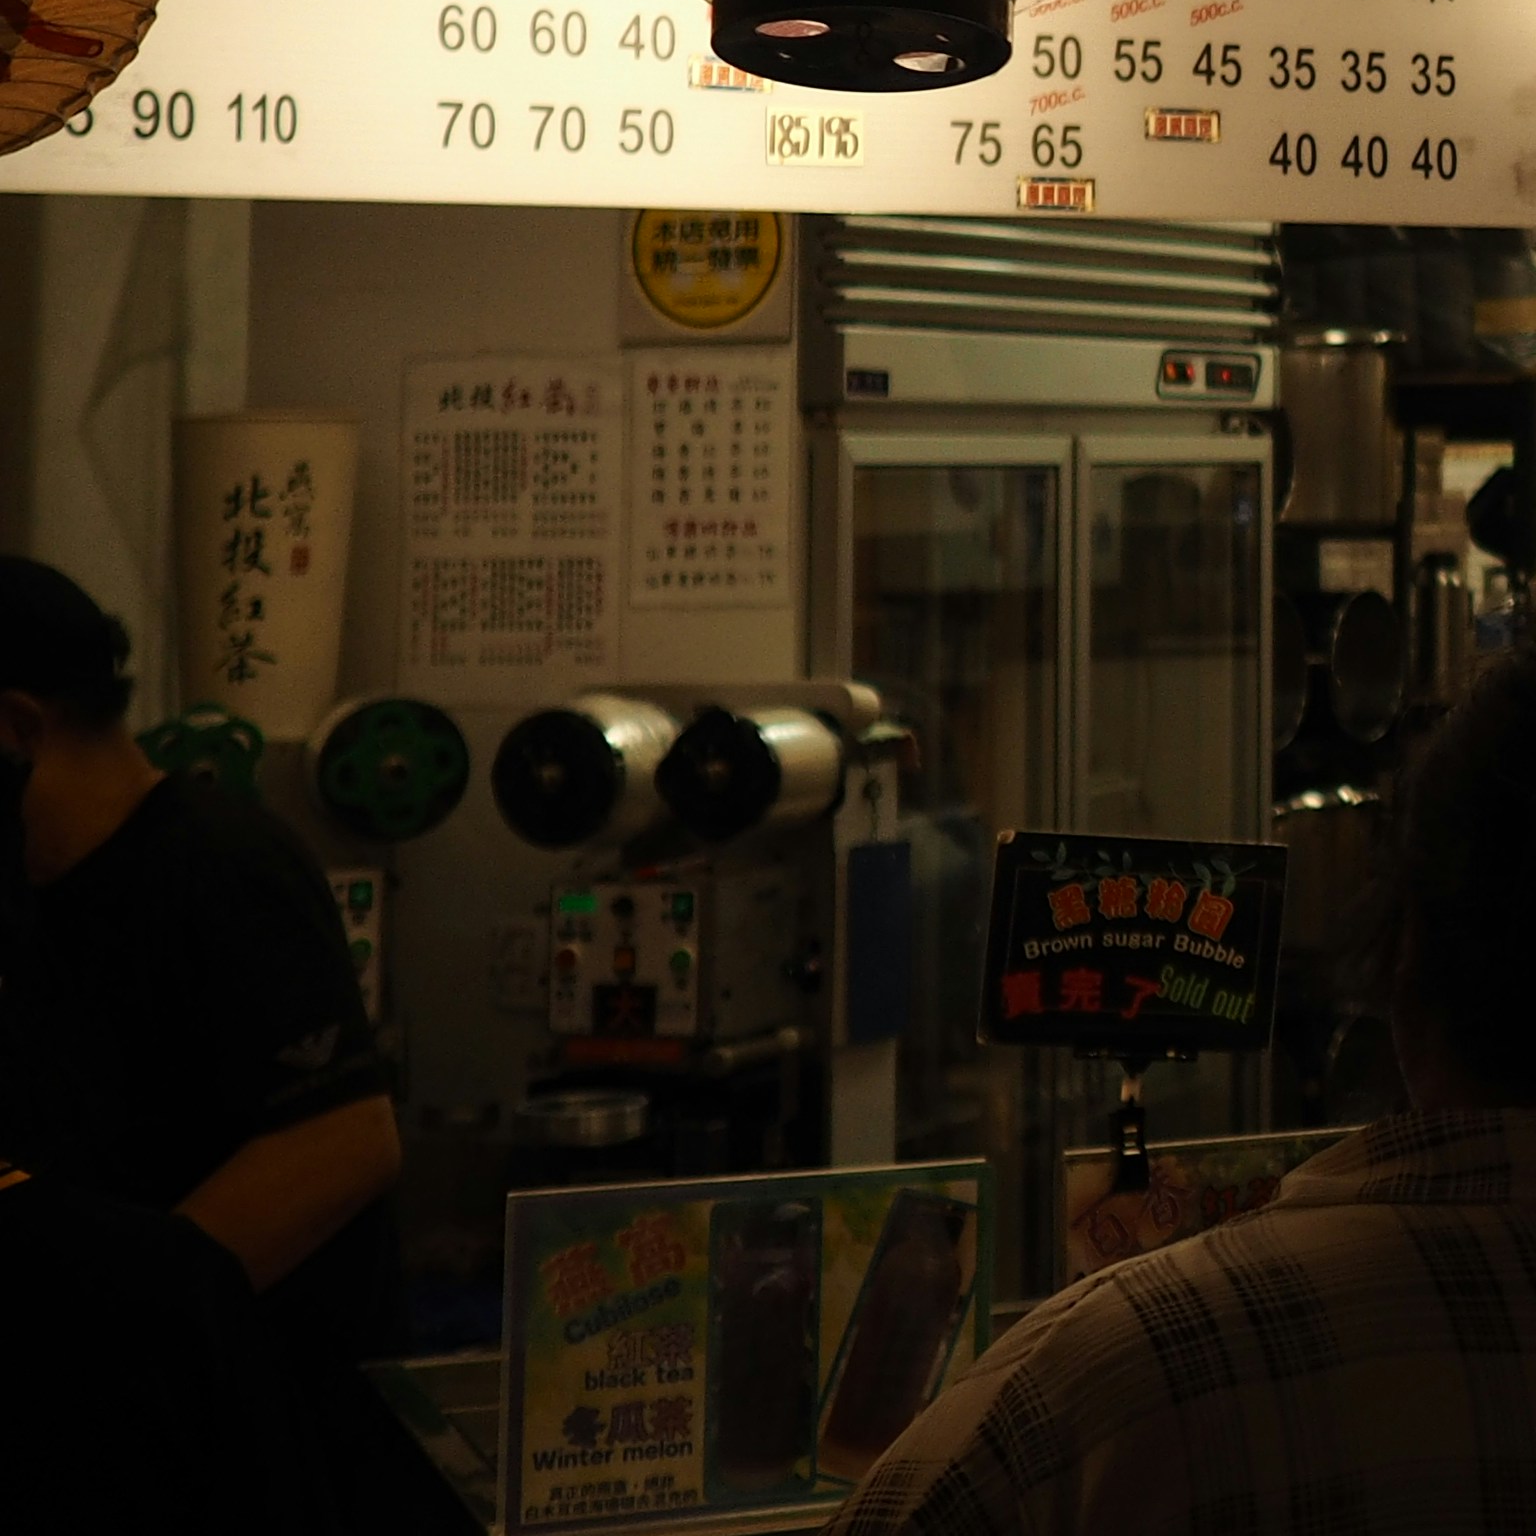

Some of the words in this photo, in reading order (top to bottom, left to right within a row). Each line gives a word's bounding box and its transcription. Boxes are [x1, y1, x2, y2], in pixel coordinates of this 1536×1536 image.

[437, 5, 498, 54] 60
[529, 9, 588, 57] 60
[618, 14, 676, 62] 40
[1032, 34, 1083, 81] 50
[1114, 39, 1163, 83] 55
[1192, 44, 1243, 87] 45
[1268, 47, 1316, 91] 35
[1340, 50, 1387, 94] 35
[1411, 53, 1457, 97] 35
[132, 89, 195, 141] 90
[226, 93, 299, 145] 110
[437, 100, 497, 150] 70
[529, 104, 587, 154] 70
[618, 108, 676, 156] 50
[951, 120, 1002, 167] 75
[1031, 123, 1084, 168] 65
[1268, 132, 1318, 177] 40
[1341, 135, 1389, 179] 40
[1411, 137, 1459, 181] 40
[1046, 874, 1236, 942] 黑糖粉圓
[1023, 931, 1093, 960] Brown
[1101, 930, 1166, 950] sugar
[1173, 932, 1245, 970] Bubble
[1159, 963, 1210, 1010] Sold
[1211, 988, 1257, 1025] out
[584, 1366, 647, 1392] black
[656, 1364, 695, 1385] tea
[532, 1443, 614, 1471] Winter
[621, 1439, 694, 1464] melon
